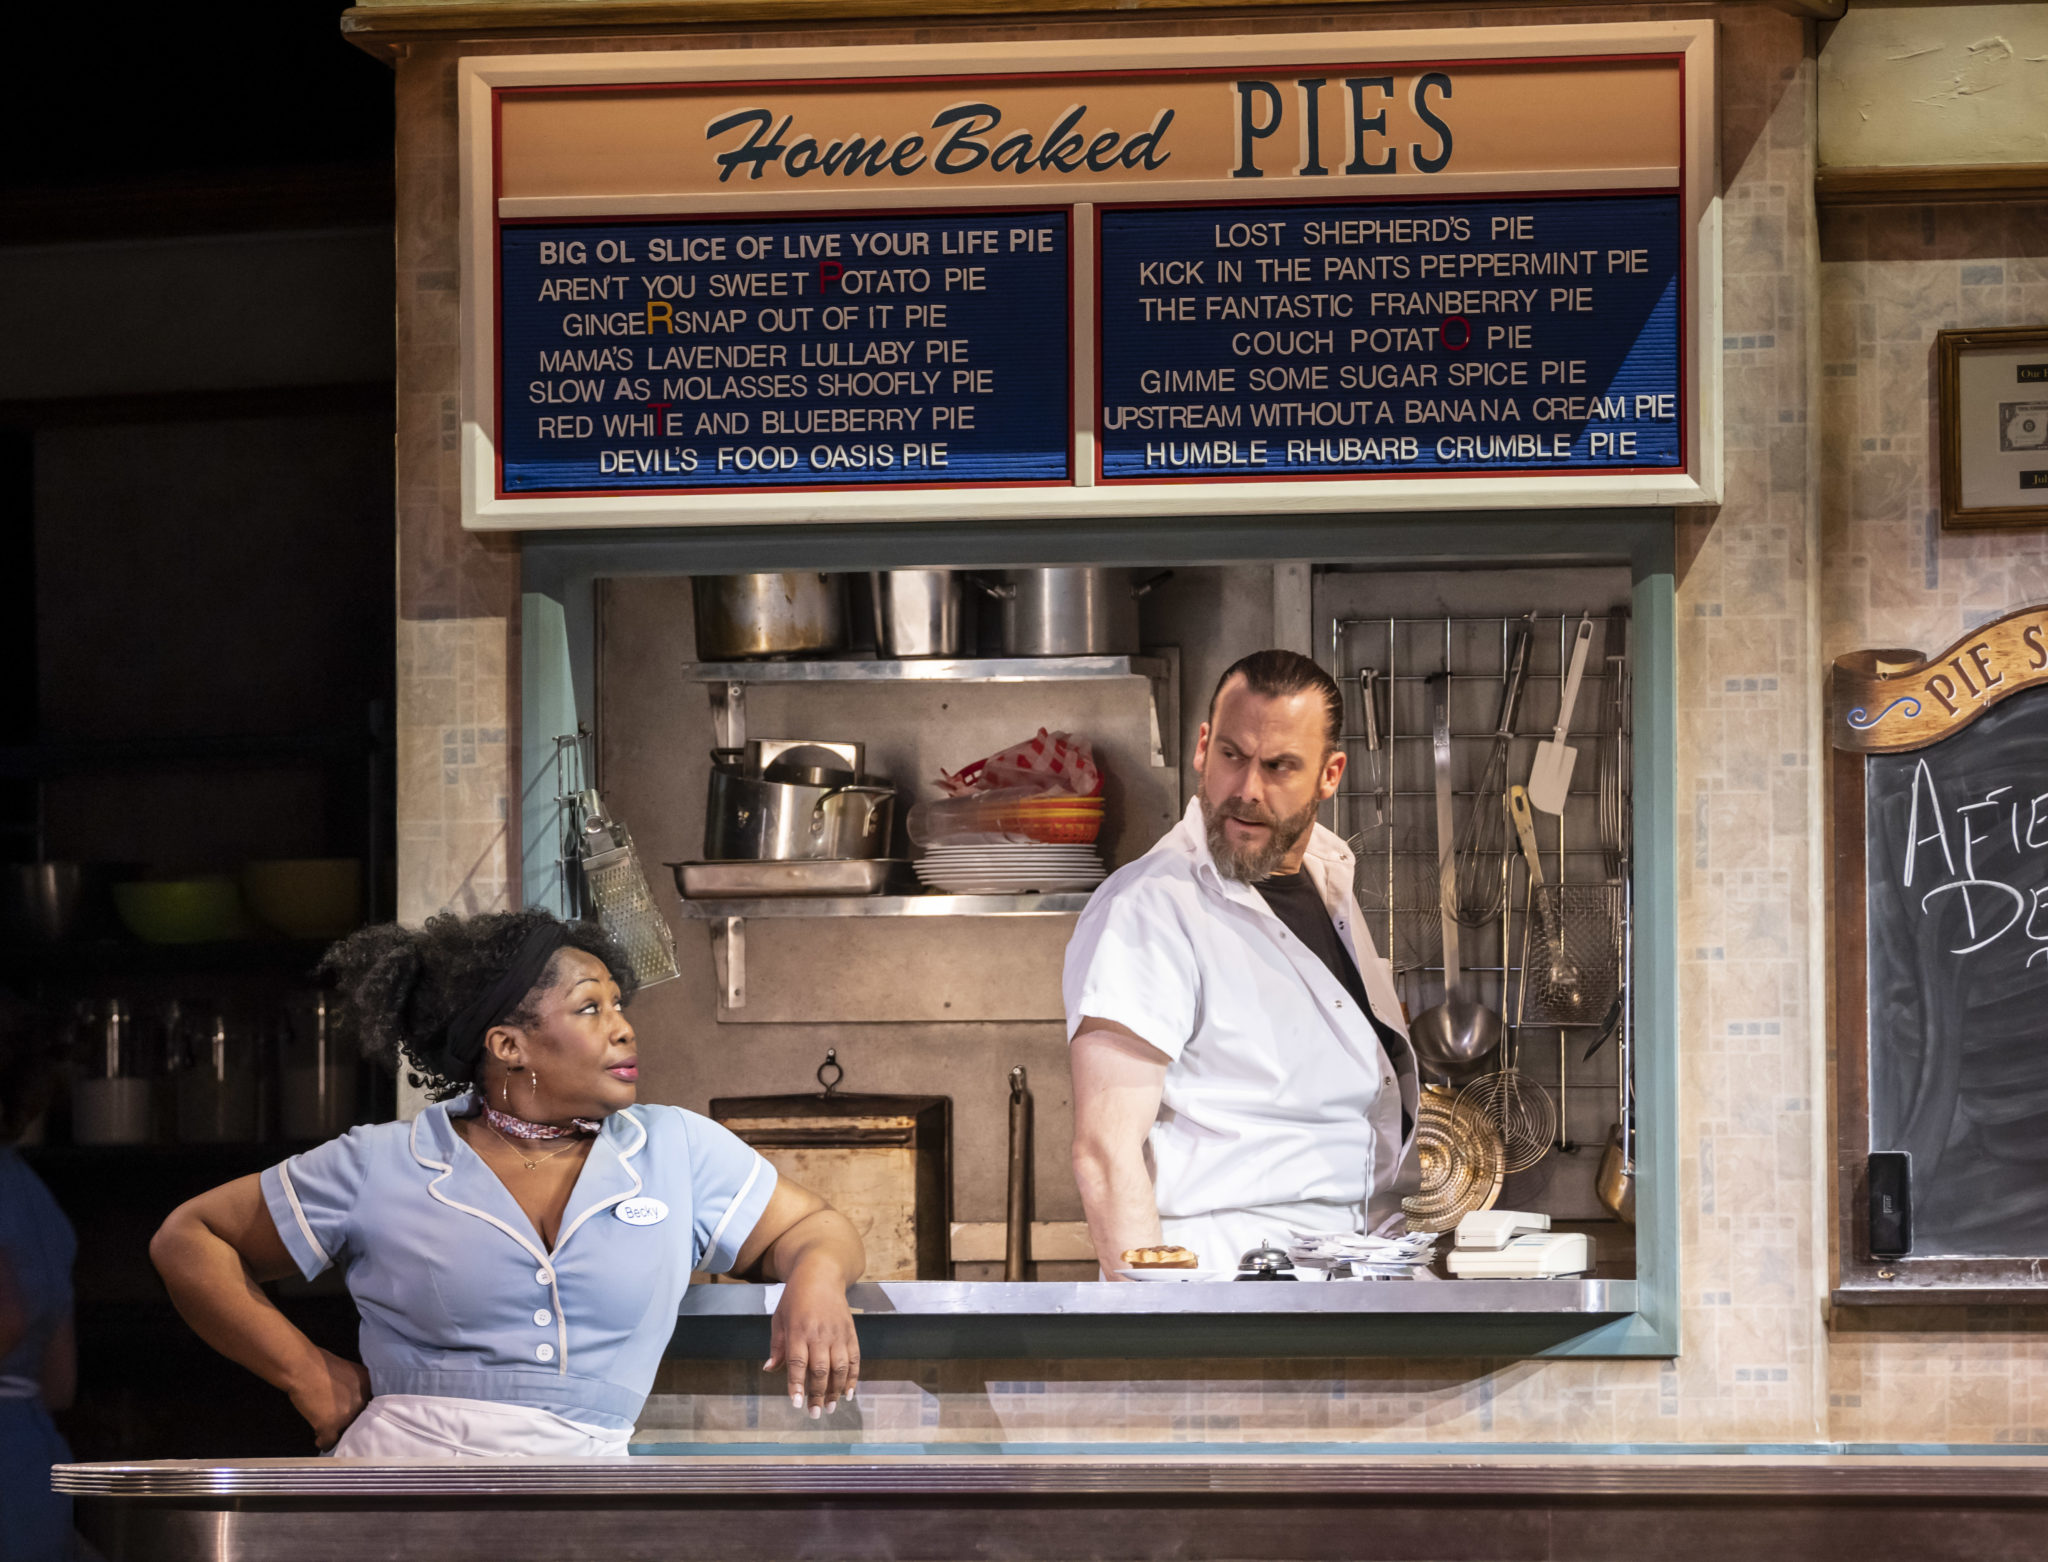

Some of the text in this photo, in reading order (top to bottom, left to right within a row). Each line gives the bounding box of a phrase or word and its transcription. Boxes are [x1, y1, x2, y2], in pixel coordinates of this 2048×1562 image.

[1230, 72, 1453, 177] PIES
[541, 229, 1052, 264] BIG OL SLICE OF LIVE YOUR LIFE PIE
[1216, 216, 1533, 247] LOST SHEPHERD'S PIE
[539, 261, 986, 301] AREN'T YOU SWEET POTATO PIE
[1141, 250, 1648, 285] KICK IN THE PANTS PEPPERMINT PIE
[563, 301, 946, 336] GINGERSNAP OUT OF IT PIE
[1139, 288, 1592, 321] THE FANTASTIC FRANBERRY PIE
[1233, 316, 1531, 355] COUCH POTATO PIE
[541, 340, 968, 371] MAMA'S LAVENDER LULLABY PIE
[530, 370, 993, 403] SLOW AS MOLASSES SHOOFLY PIE
[1141, 361, 1586, 393] GIMME SOME SUGAR SPICE PIE
[539, 404, 974, 438] RED WHITE AND BLUEBERRY PIE
[1105, 394, 1675, 429] UPSTREAM WITHOUT A BANANA CREAM PIE
[601, 443, 948, 472] DEVIL'S FOOD OASIS PIE
[1147, 432, 1637, 465] HUMBLE RHUBARB CRUMBLE PIE
[1924, 642, 2004, 717] PIE
